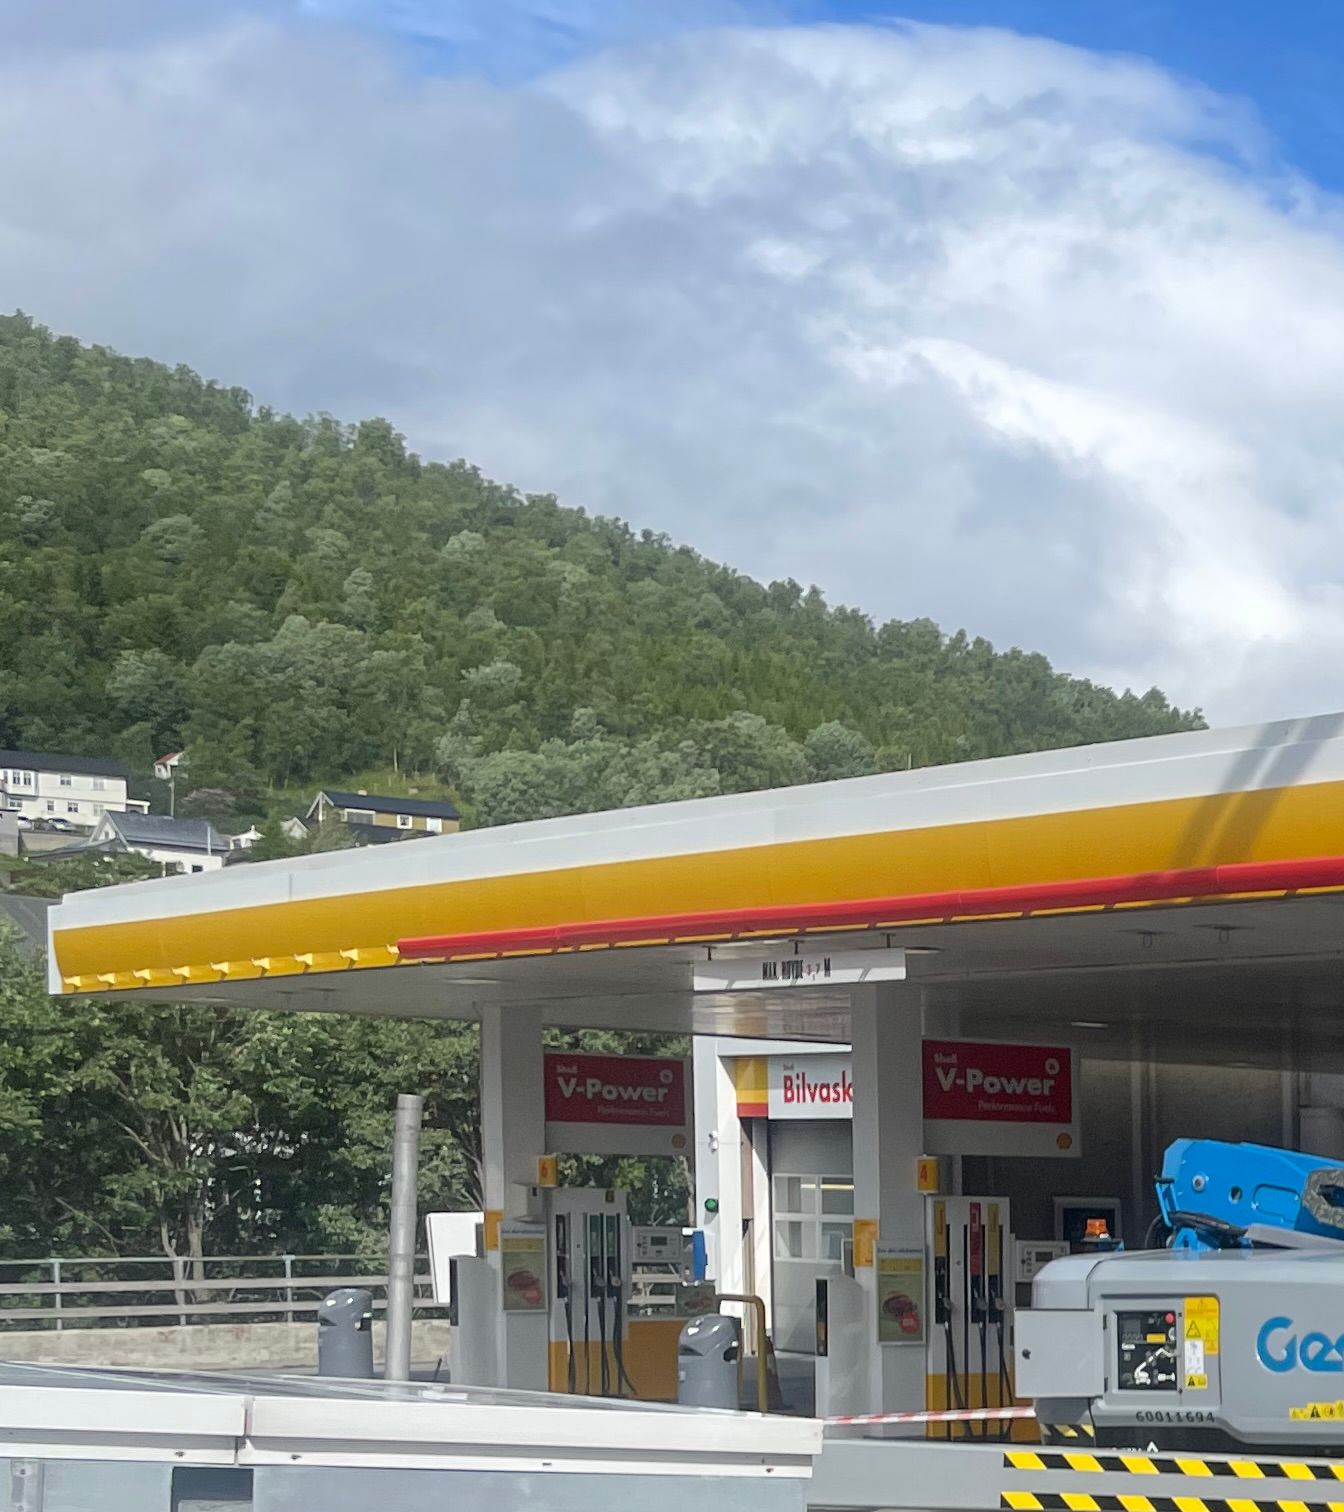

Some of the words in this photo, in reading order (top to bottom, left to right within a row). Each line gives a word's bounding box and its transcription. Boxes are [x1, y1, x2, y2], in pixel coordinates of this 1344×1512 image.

[558, 1077, 669, 1102] V-Power
[783, 1070, 855, 1103] Bilvask
[935, 1067, 1056, 1096] V-Power
